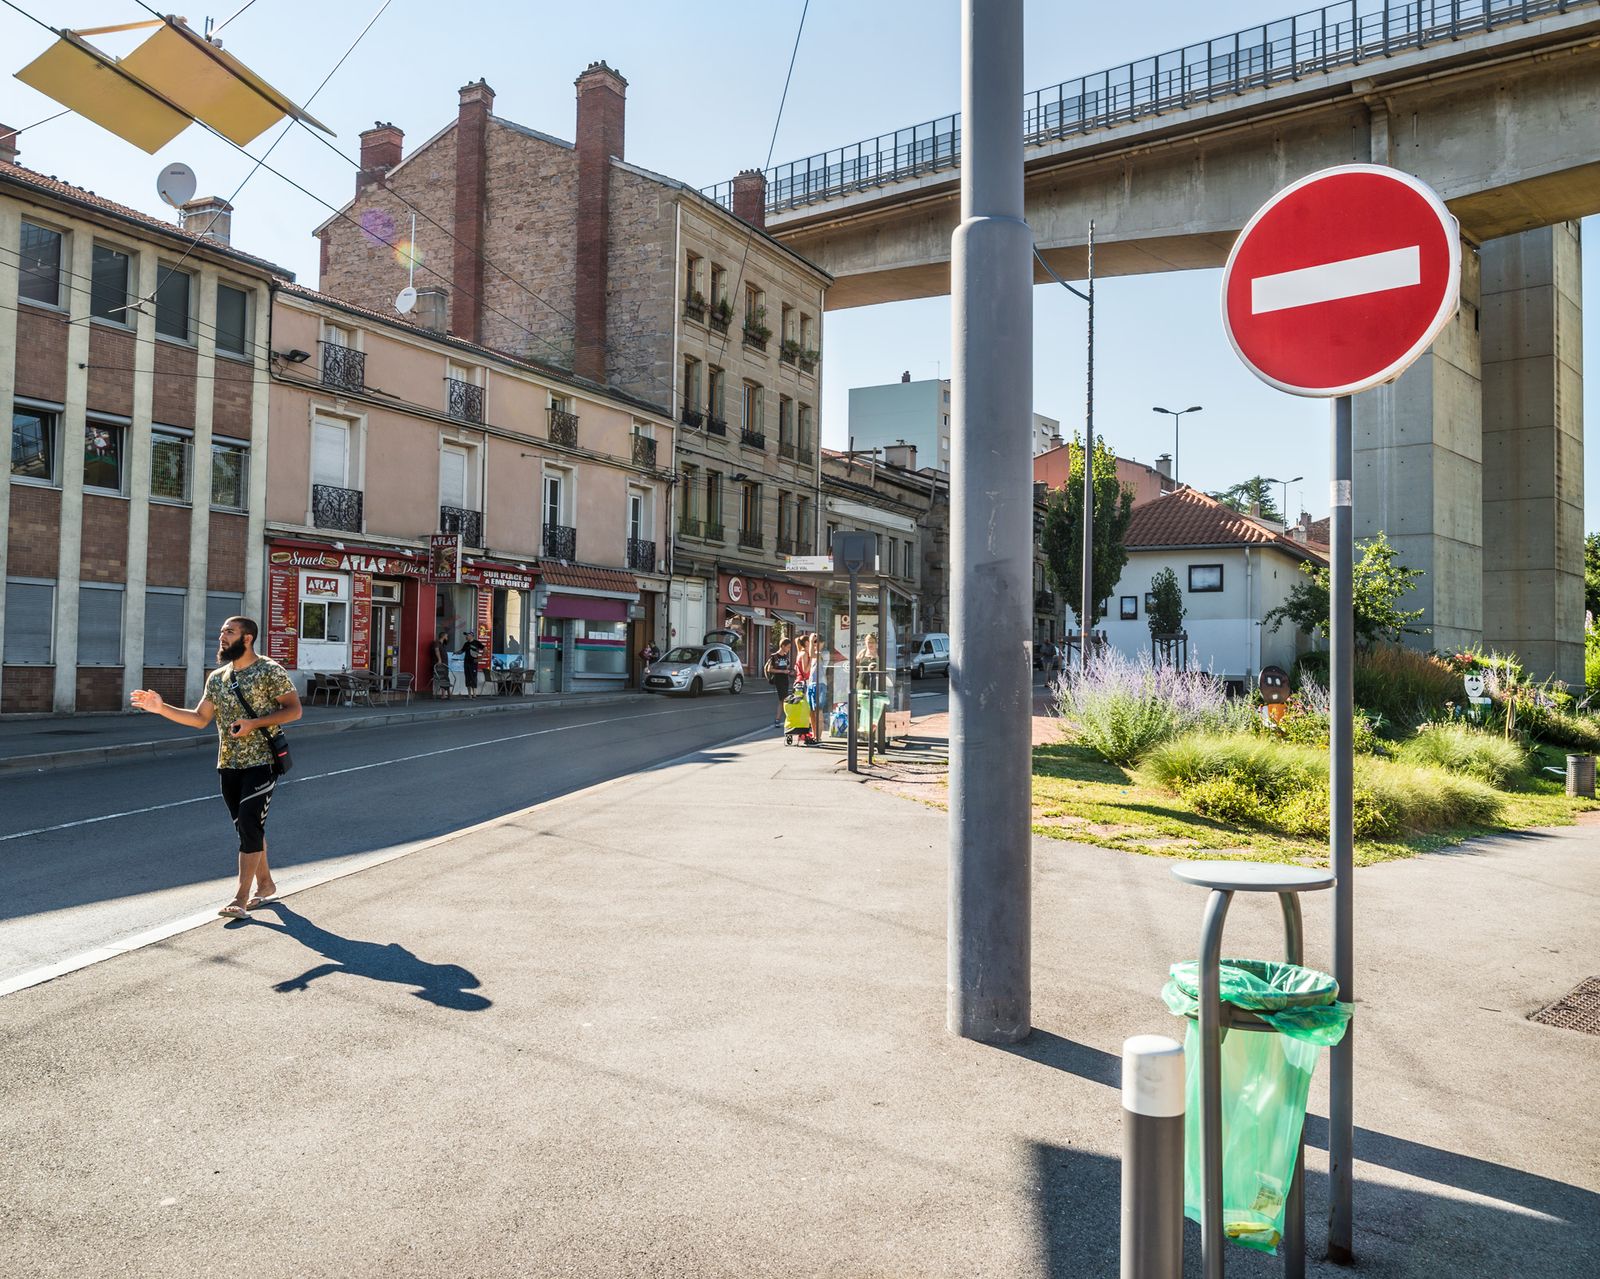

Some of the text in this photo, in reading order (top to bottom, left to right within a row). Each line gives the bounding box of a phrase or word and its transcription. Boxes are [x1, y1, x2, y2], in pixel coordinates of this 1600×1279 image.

[432, 536, 457, 546] ATLAS
[290, 550, 325, 566] Snack
[340, 554, 387, 573] ATLAS
[483, 570, 499, 578] SUR
[500, 572, 523, 581] PLACE
[308, 579, 337, 590] ATLAS
[490, 578, 531, 588] EMPORTER
